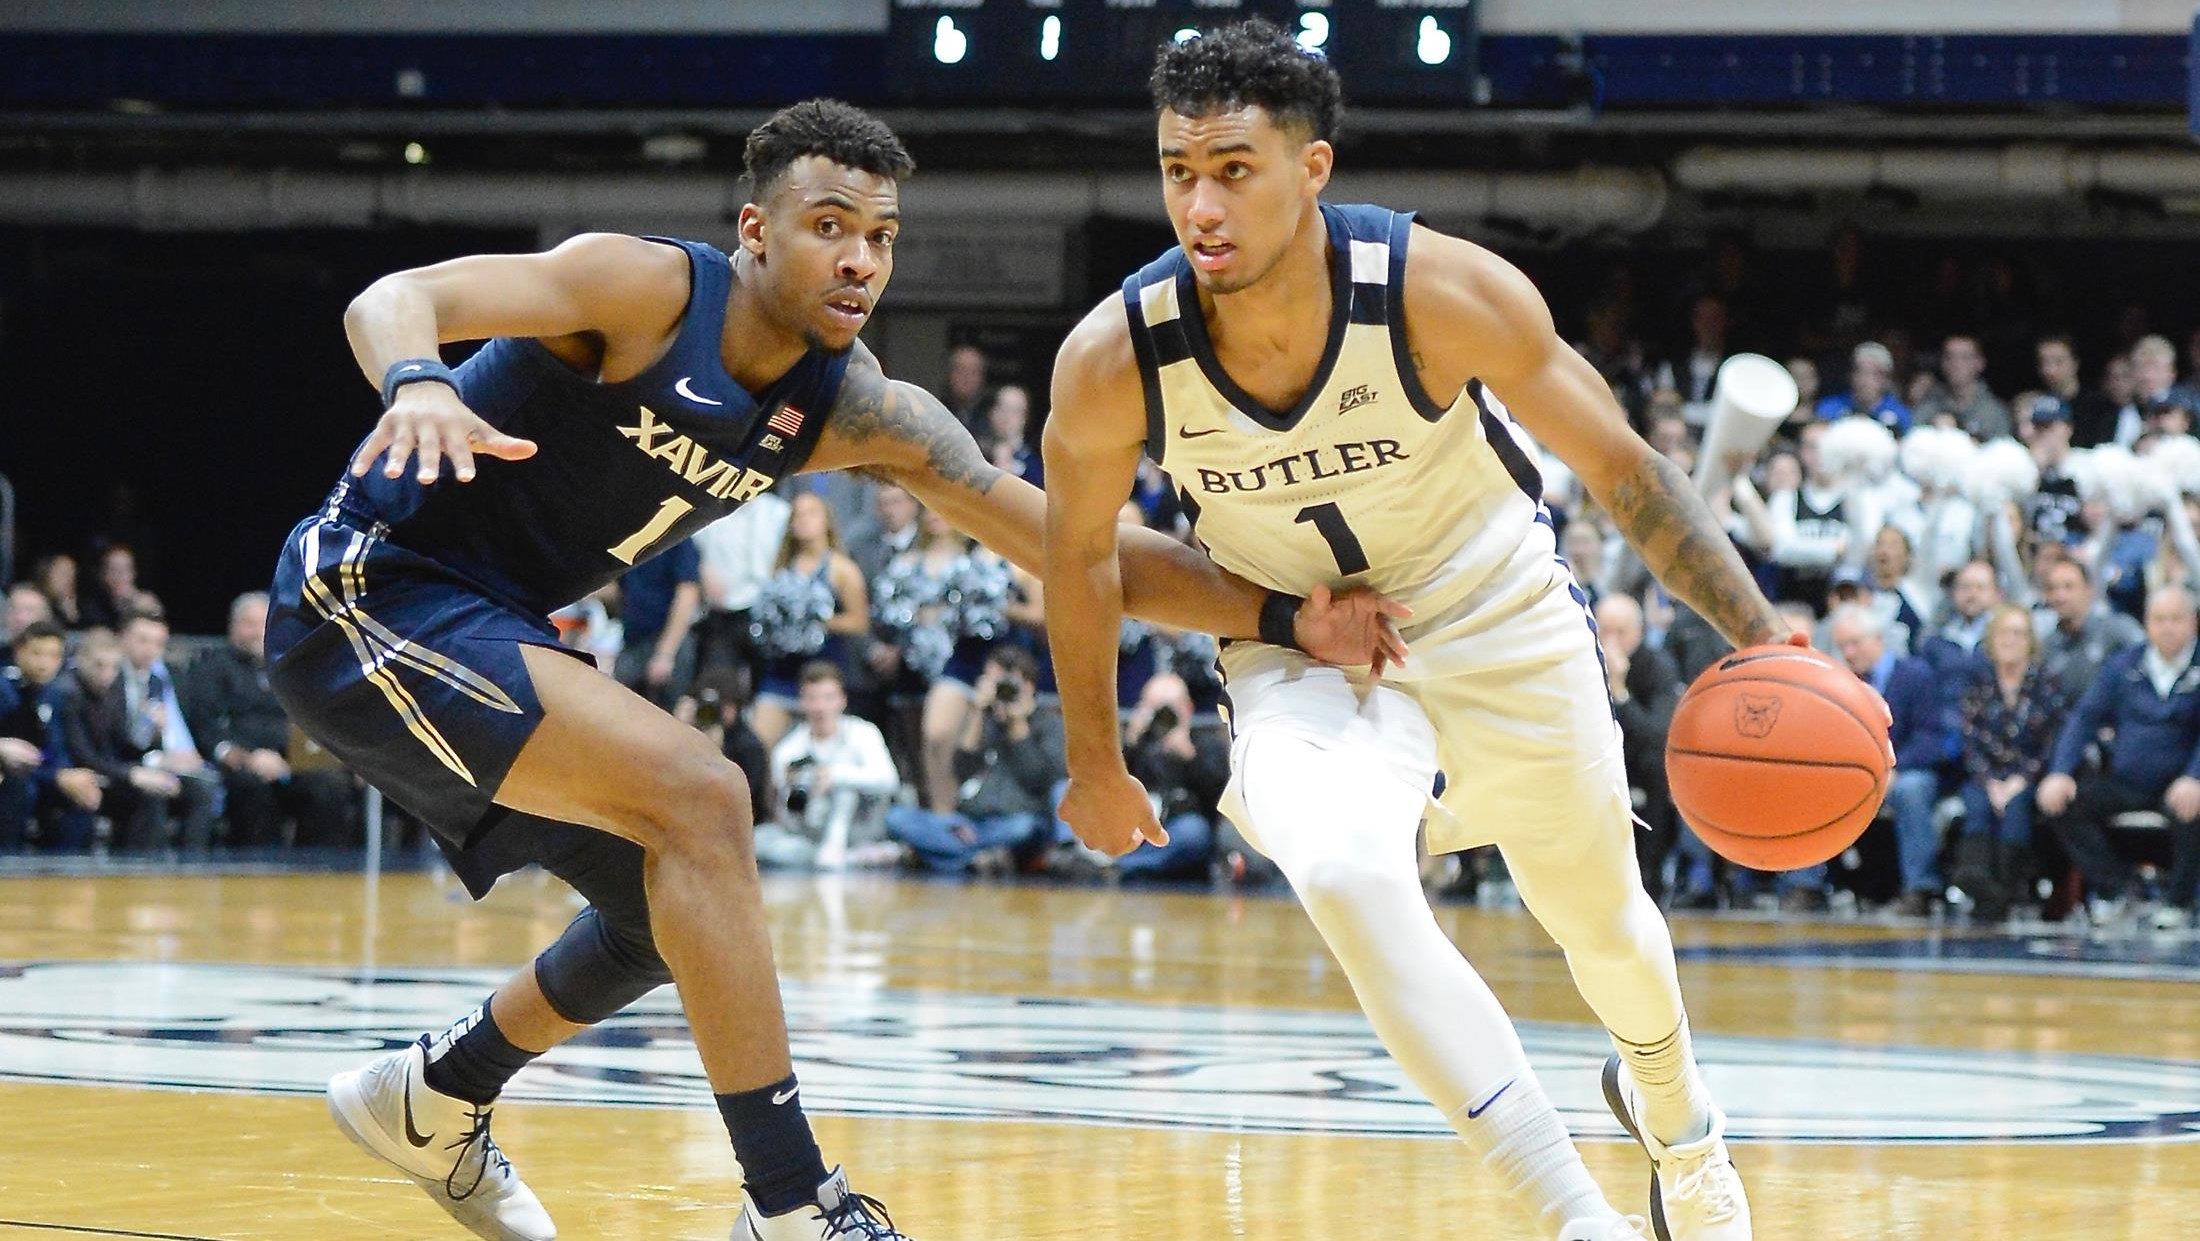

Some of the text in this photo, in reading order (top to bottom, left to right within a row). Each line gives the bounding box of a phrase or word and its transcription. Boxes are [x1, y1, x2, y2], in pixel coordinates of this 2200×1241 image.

[1041, 15, 1061, 61] 1
[1339, 391, 1378, 411] EAST
[1341, 384, 1368, 401] BIG
[616, 406, 774, 501] XAVIR
[1197, 439, 1410, 493] BUTLER
[607, 495, 696, 566] 1
[1294, 502, 1371, 576] 1
